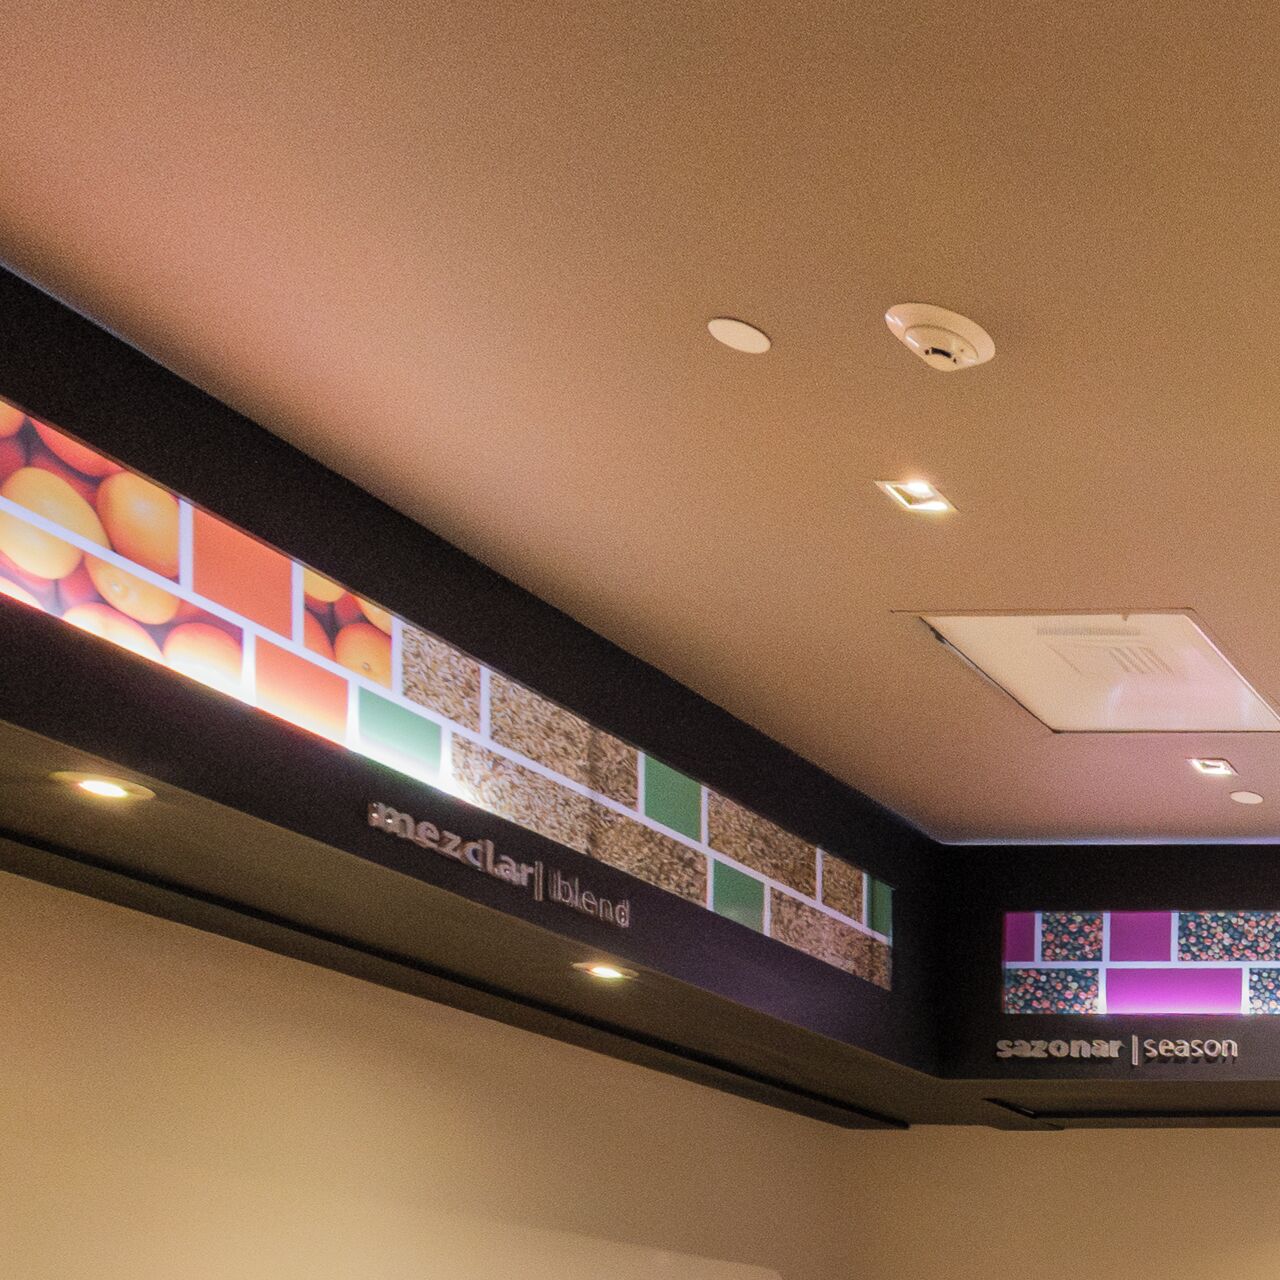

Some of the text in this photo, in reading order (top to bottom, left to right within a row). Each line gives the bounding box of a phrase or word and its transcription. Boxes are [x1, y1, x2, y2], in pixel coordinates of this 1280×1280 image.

[368, 802, 631, 929] mezclar blend
[996, 1038, 1239, 1059] sazonar season
